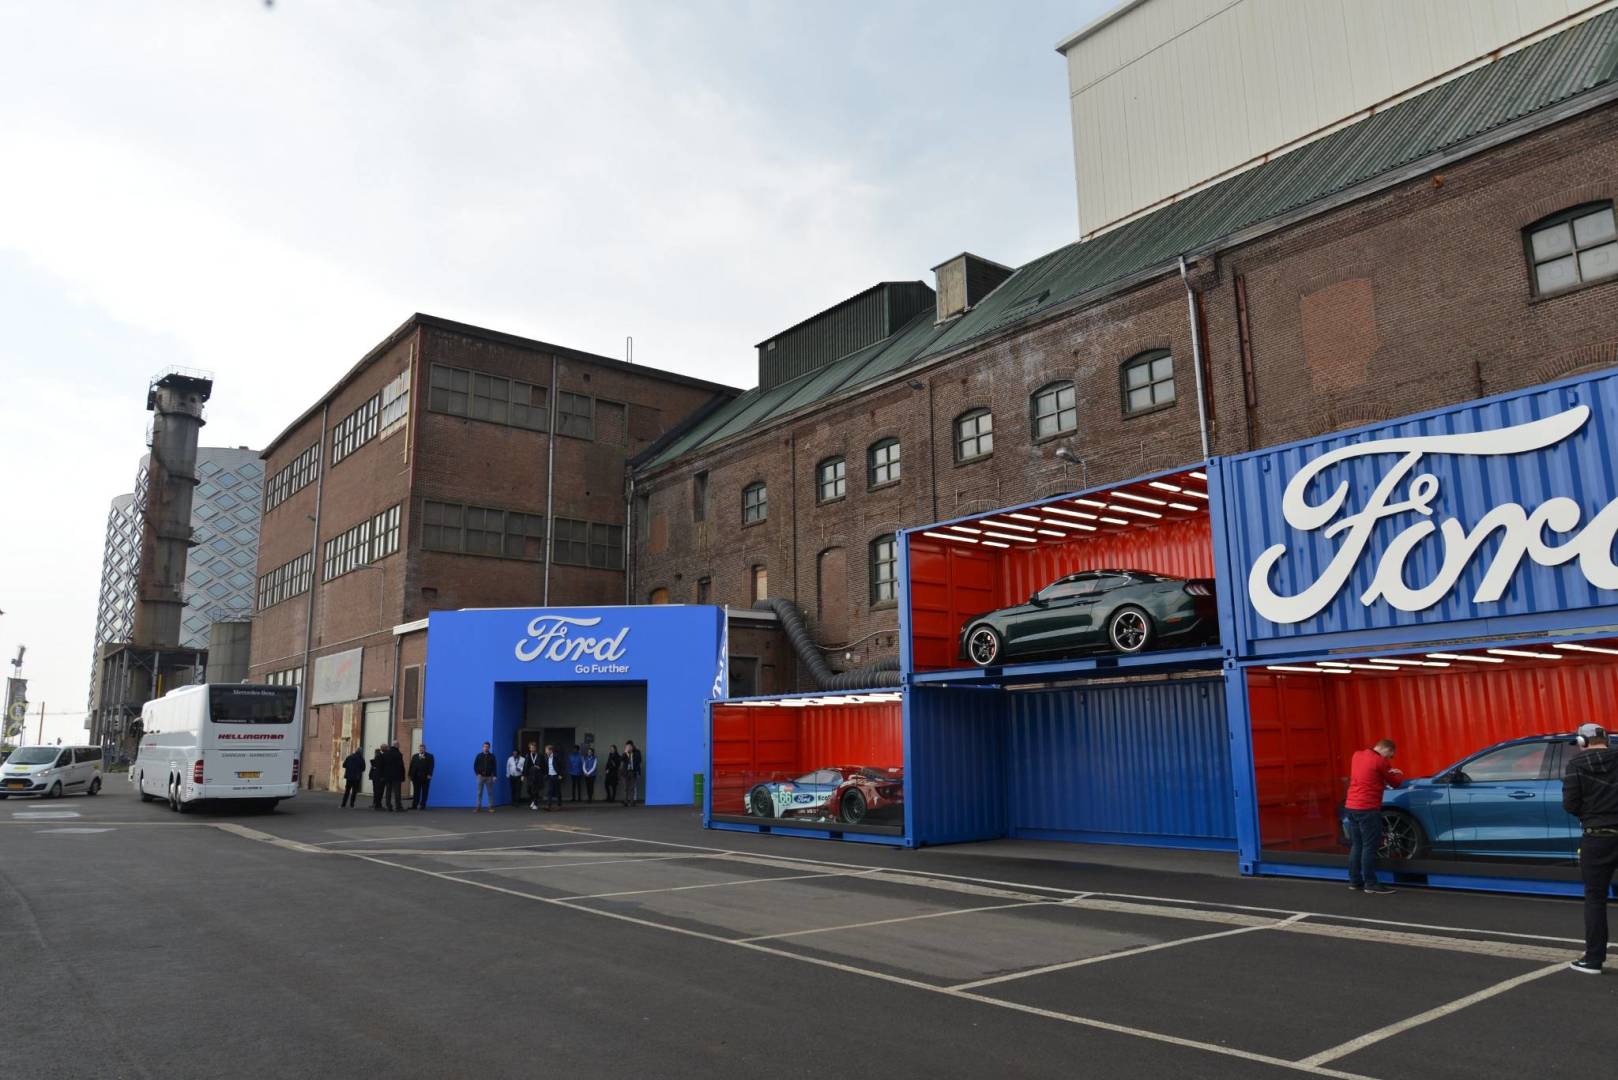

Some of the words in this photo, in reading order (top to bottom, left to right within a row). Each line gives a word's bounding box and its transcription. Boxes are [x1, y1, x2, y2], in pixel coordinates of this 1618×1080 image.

[1249, 405, 1618, 624] For
[515, 615, 630, 662] Ford
[575, 664, 590, 674] Go
[591, 663, 630, 673] Further
